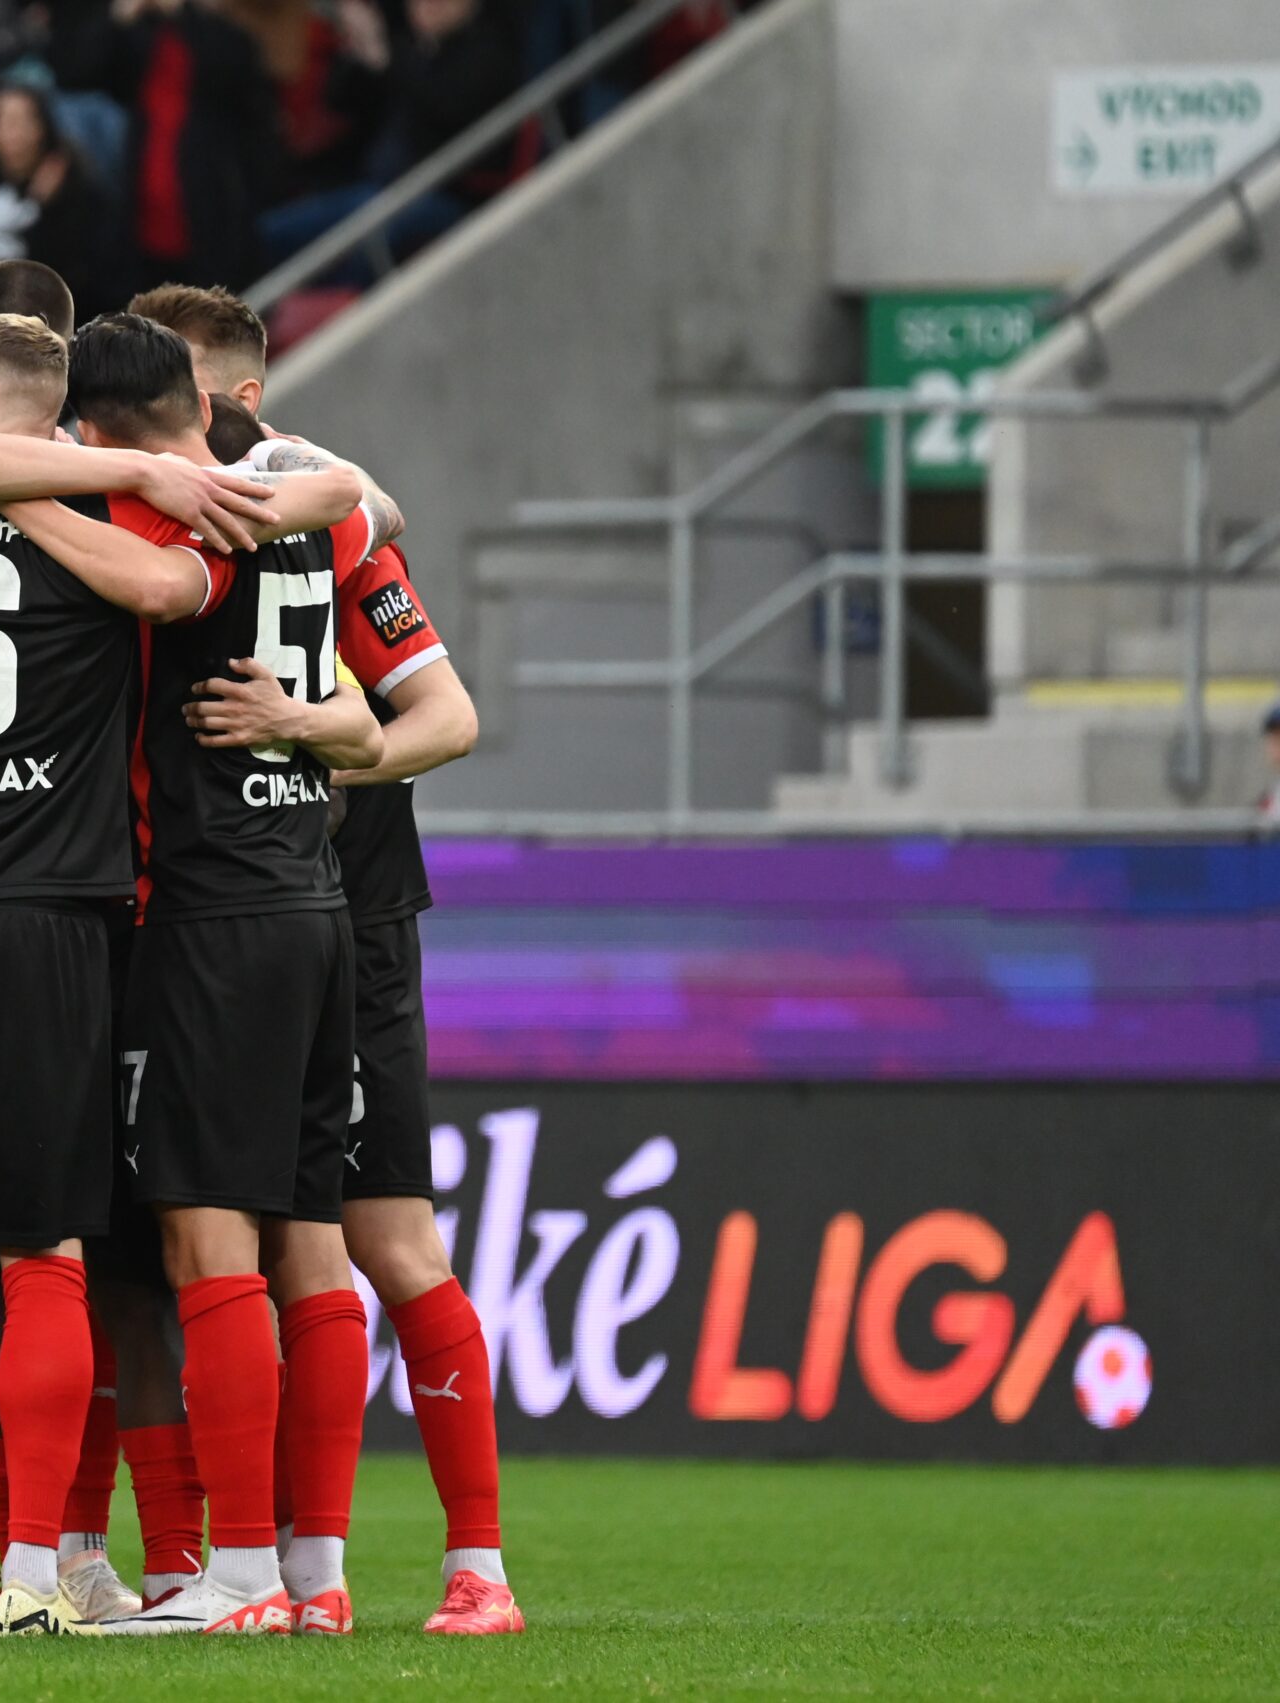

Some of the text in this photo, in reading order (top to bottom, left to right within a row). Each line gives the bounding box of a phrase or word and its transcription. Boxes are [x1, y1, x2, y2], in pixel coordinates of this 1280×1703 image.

[1135, 136, 1218, 181] EXIT
[371, 587, 412, 627] niké
[688, 1209, 1126, 1424] LIGA
